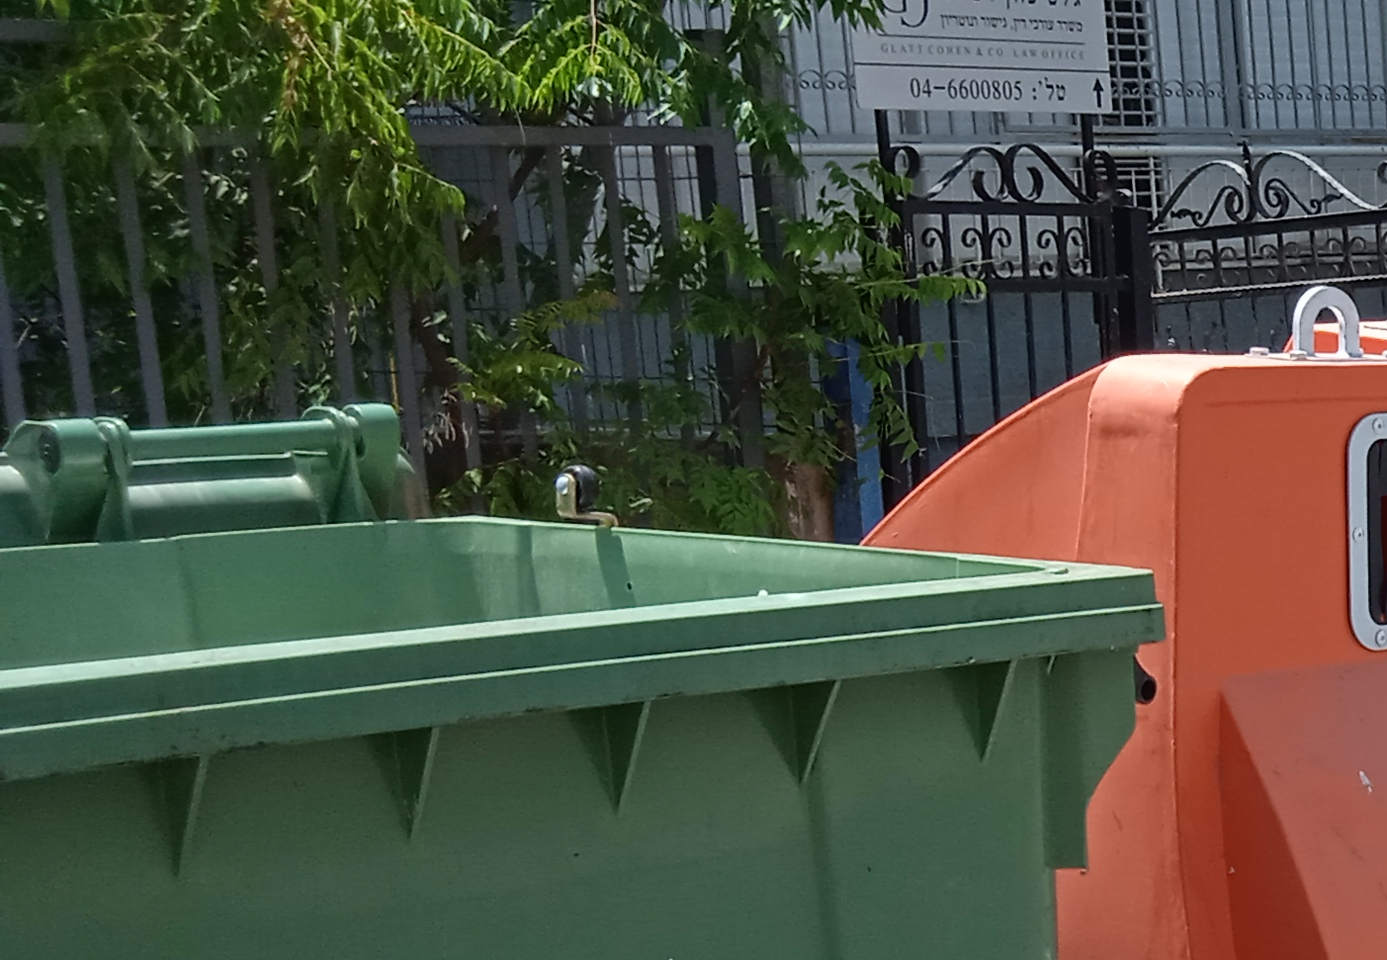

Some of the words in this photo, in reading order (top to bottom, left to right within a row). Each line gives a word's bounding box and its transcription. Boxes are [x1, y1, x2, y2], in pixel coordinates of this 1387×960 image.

[881, 42, 923, 54] GLATT
[928, 44, 971, 57] COHEN
[976, 46, 983, 57] &
[1013, 48, 1038, 59] LAW
[1041, 49, 1086, 61] OFFICE
[910, 77, 1023, 101] 04-6600805
